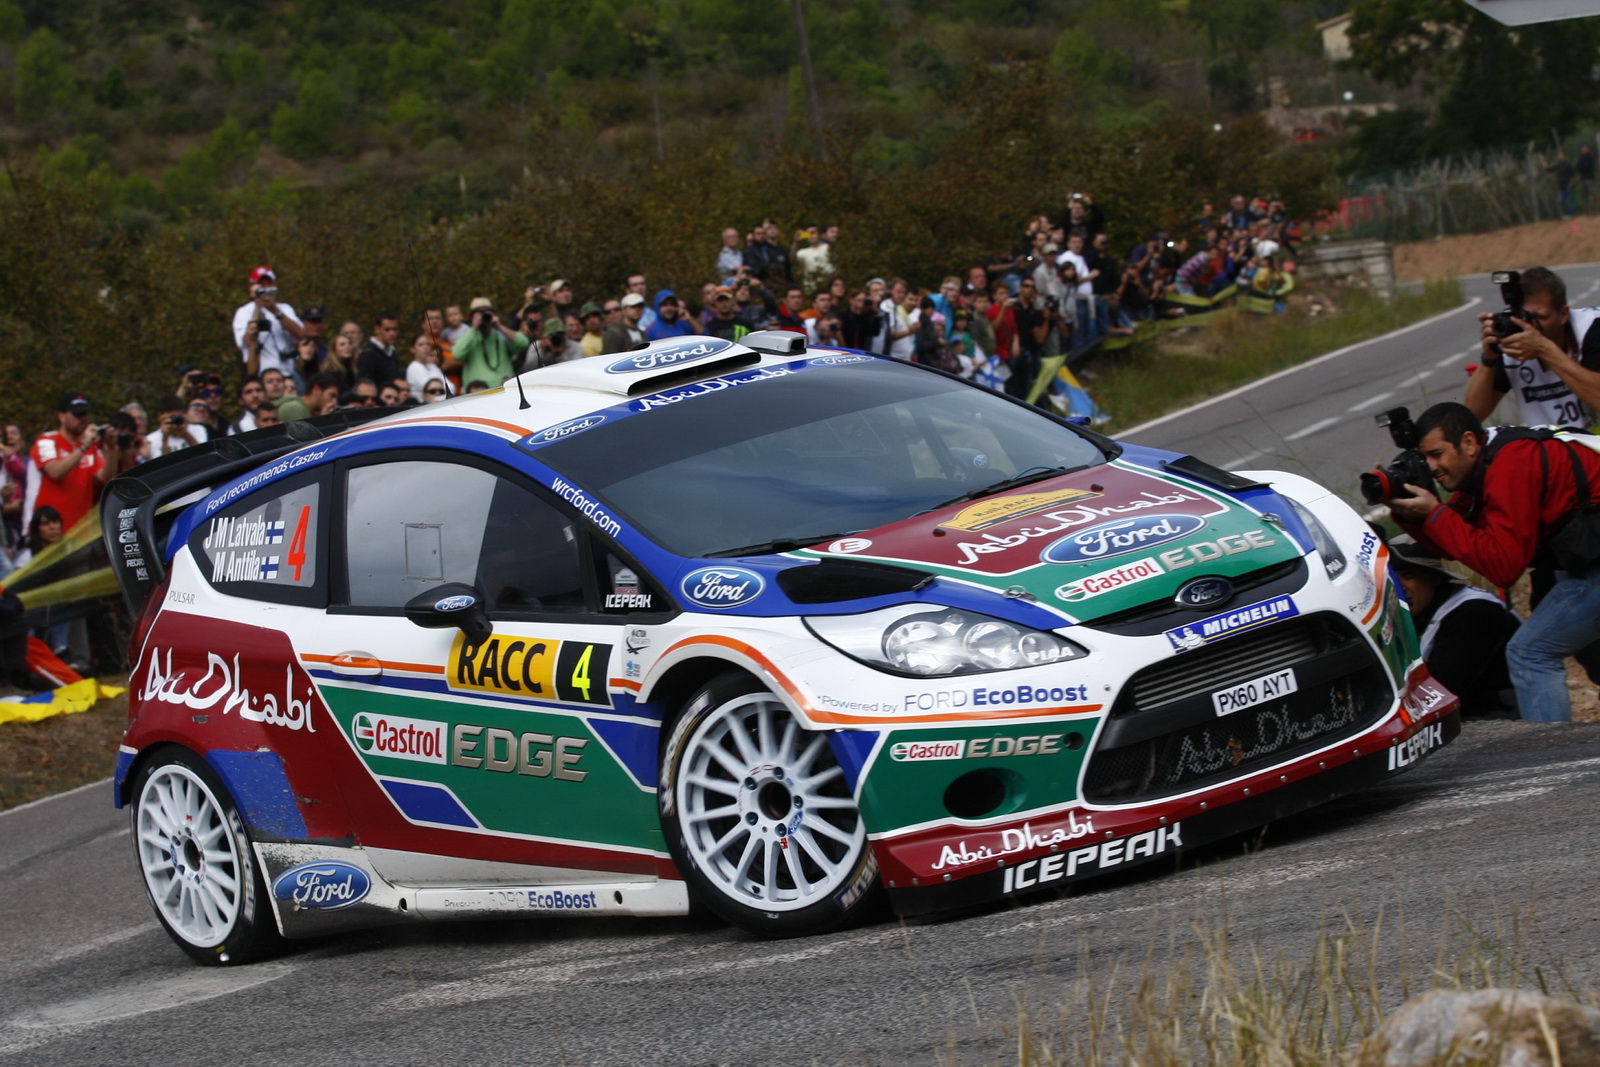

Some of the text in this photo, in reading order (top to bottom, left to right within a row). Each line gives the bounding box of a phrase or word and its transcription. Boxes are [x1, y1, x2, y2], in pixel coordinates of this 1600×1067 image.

[632, 344, 714, 369] Ford
[822, 355, 867, 366] Ford
[544, 419, 594, 441] Ford
[205, 447, 329, 514] Ford recommends Castrol
[551, 477, 622, 538] wrcford.com
[124, 544, 140, 553] OZ
[205, 514, 265, 549] J M Latvala
[287, 505, 311, 582] 4
[1074, 520, 1181, 556] Ford
[212, 550, 261, 583] M Anttila
[1083, 529, 1276, 594] Castrol EDGE
[169, 590, 196, 605] PULSAR
[605, 594, 651, 609] ICEPEAK
[693, 571, 750, 601] Ford
[1190, 582, 1222, 602] Ford
[441, 598, 468, 611] Ford
[1202, 598, 1290, 636] MICHELIN
[457, 639, 593, 701] RACC 4
[883, 702, 898, 714] by
[904, 689, 968, 711] FORD
[973, 684, 1088, 706] EcoBoost
[1217, 672, 1292, 713] PX60 AYT
[376, 719, 590, 782] Castrol EDGE
[909, 734, 1065, 759] Castrol EDGE
[1388, 722, 1442, 771] ICEPEAK
[1003, 822, 1184, 894] ICEPEAK
[294, 868, 356, 906] Ford
[528, 891, 597, 909] EcoBoost
